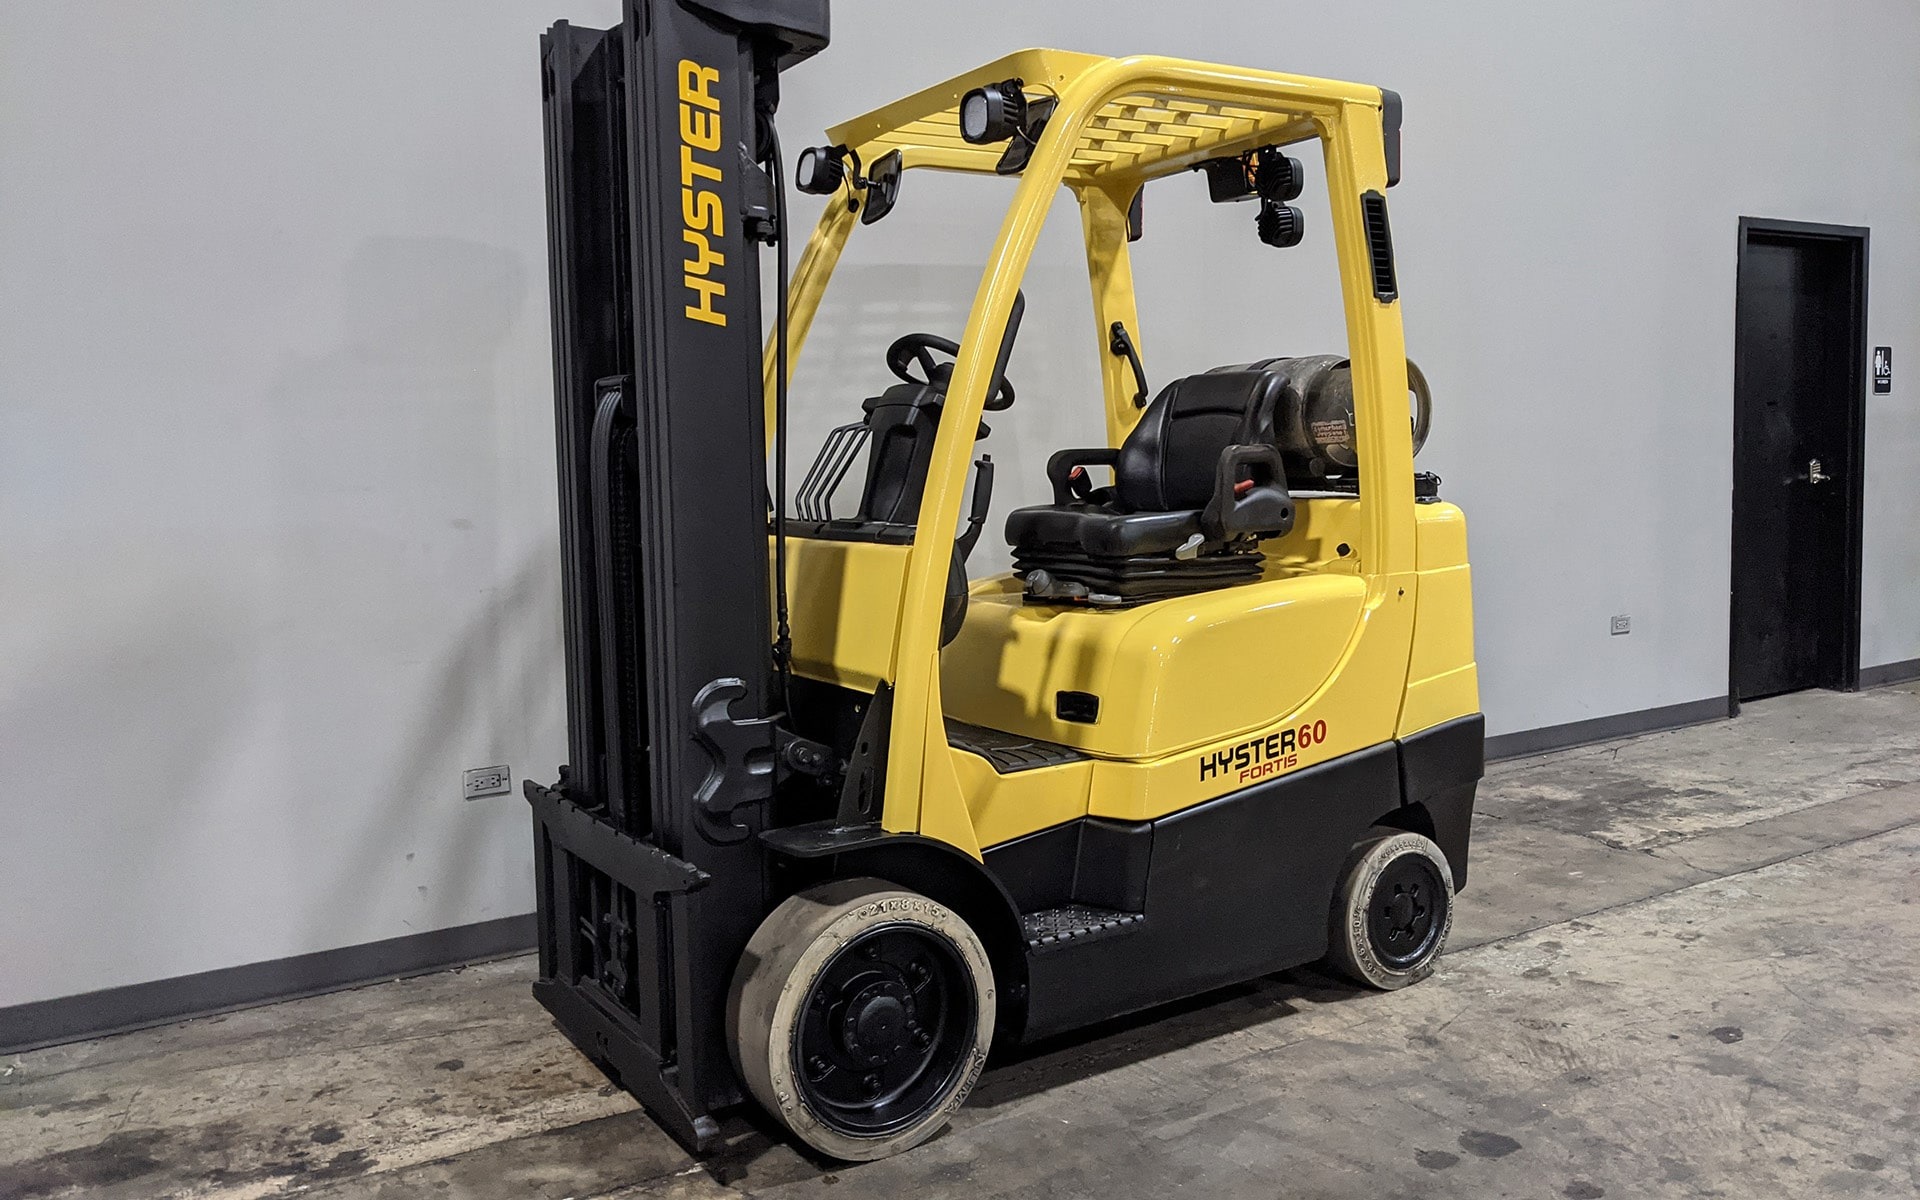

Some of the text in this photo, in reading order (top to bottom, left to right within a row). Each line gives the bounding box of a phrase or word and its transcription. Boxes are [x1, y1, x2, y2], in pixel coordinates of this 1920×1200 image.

[678, 59, 727, 327] HYSTER
[1200, 719, 1327, 782] HYSTER 60
[1239, 753, 1298, 783] FORTIS
